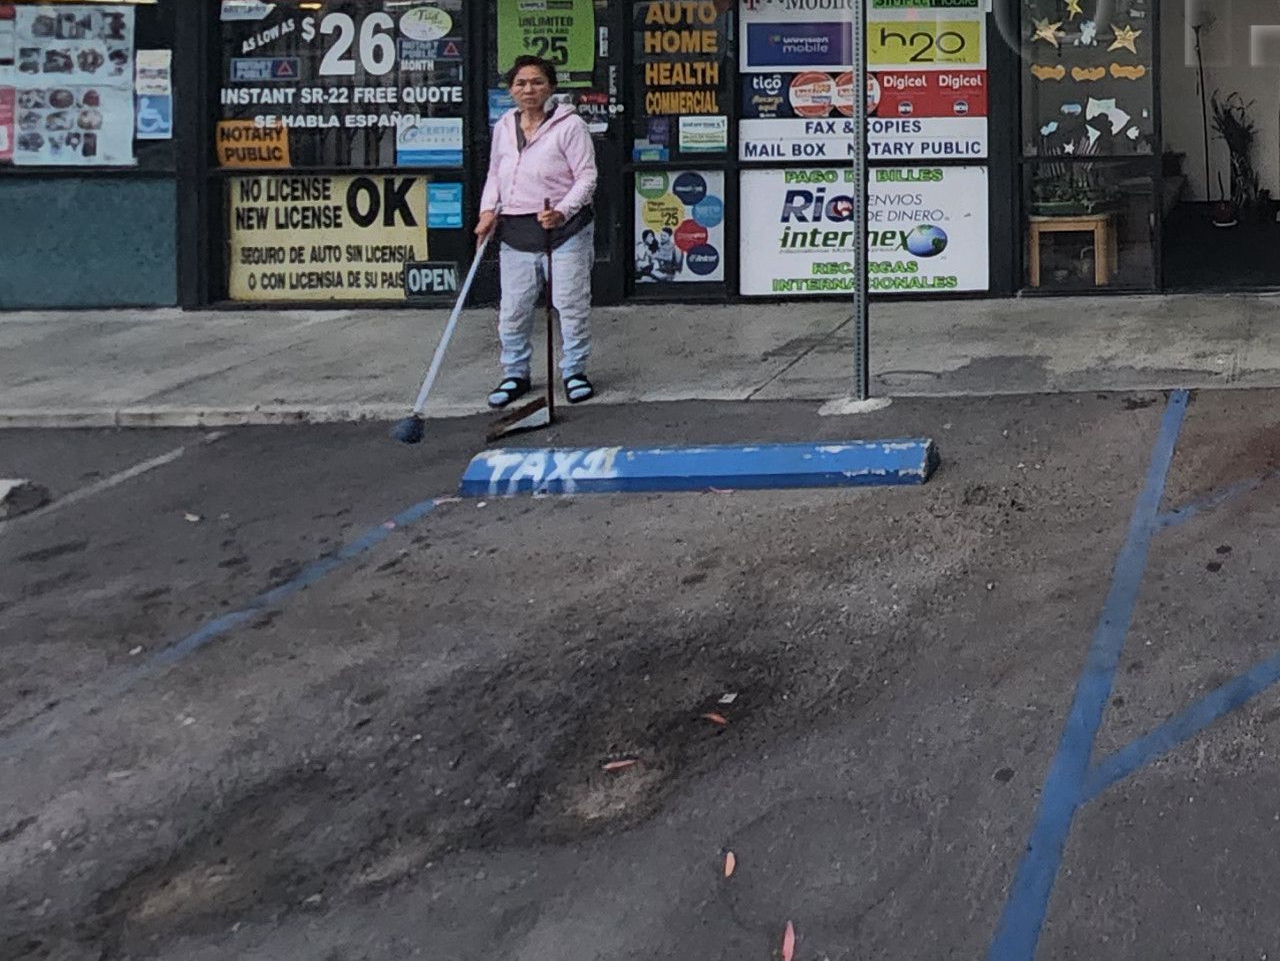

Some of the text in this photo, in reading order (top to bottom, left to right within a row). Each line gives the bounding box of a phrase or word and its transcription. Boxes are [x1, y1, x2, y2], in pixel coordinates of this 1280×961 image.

[645, 0, 718, 25] AUTO
[242, 37, 256, 54] AS
[256, 24, 280, 47] LOW
[281, 18, 295, 36] AS
[301, 11, 397, 77] $26
[522, 36, 570, 66] $25
[644, 30, 719, 55] HOME
[782, 43, 829, 54] mobile
[644, 60, 719, 85] HEALTH
[883, 75, 928, 92] Digicel
[938, 74, 983, 92] Digicel
[220, 86, 463, 105] INSTANT SR-22 FREE QUOTE
[645, 90, 720, 116] COMMERCIAL
[254, 114, 273, 128] SE
[281, 113, 341, 128] HABLA
[804, 120, 837, 135] FAX
[219, 126, 284, 144] NOTARY
[224, 146, 284, 163] PUBLIC
[744, 140, 786, 158] MAIL
[791, 142, 827, 157] BOX
[920, 140, 982, 156] PUBLIC
[875, 168, 944, 183] BILLES
[240, 177, 332, 204] NO LICENSE
[345, 176, 419, 229] OK
[779, 186, 855, 224] Ria
[235, 205, 343, 231] NEW LICENSE
[887, 209, 944, 223] DINERO
[240, 244, 417, 265] SEGURO DE AUTO SIN LICENSIA
[811, 260, 919, 276] RECRGAS
[260, 271, 286, 291] CON
[289, 271, 344, 290] LICENSIA
[347, 271, 361, 289] DE
[364, 271, 379, 289] SU
[408, 267, 458, 293] OPEN
